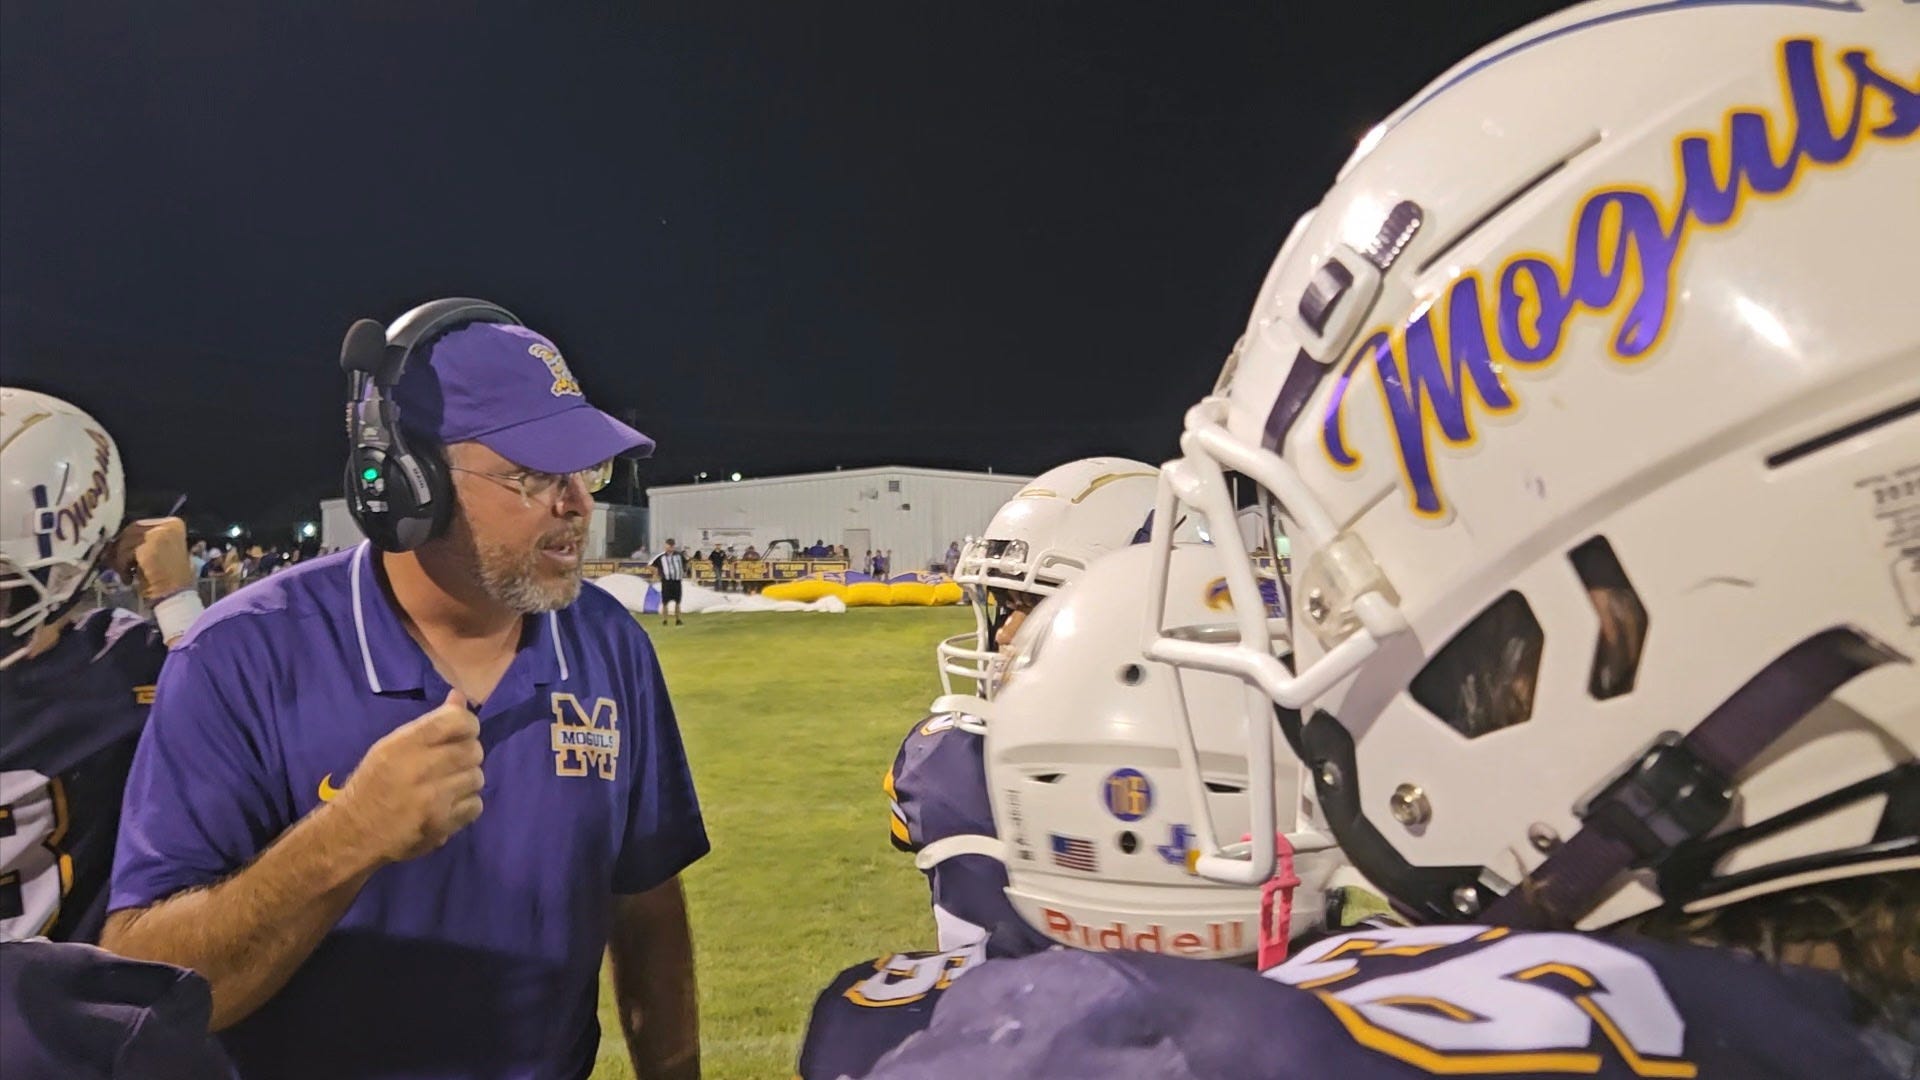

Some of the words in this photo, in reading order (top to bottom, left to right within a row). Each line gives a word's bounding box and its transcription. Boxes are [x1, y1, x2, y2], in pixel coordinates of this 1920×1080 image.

[1321, 35, 1920, 518] Moguls
[561, 731, 613, 749] MOGULS
[1041, 907, 1246, 954] Riddell
